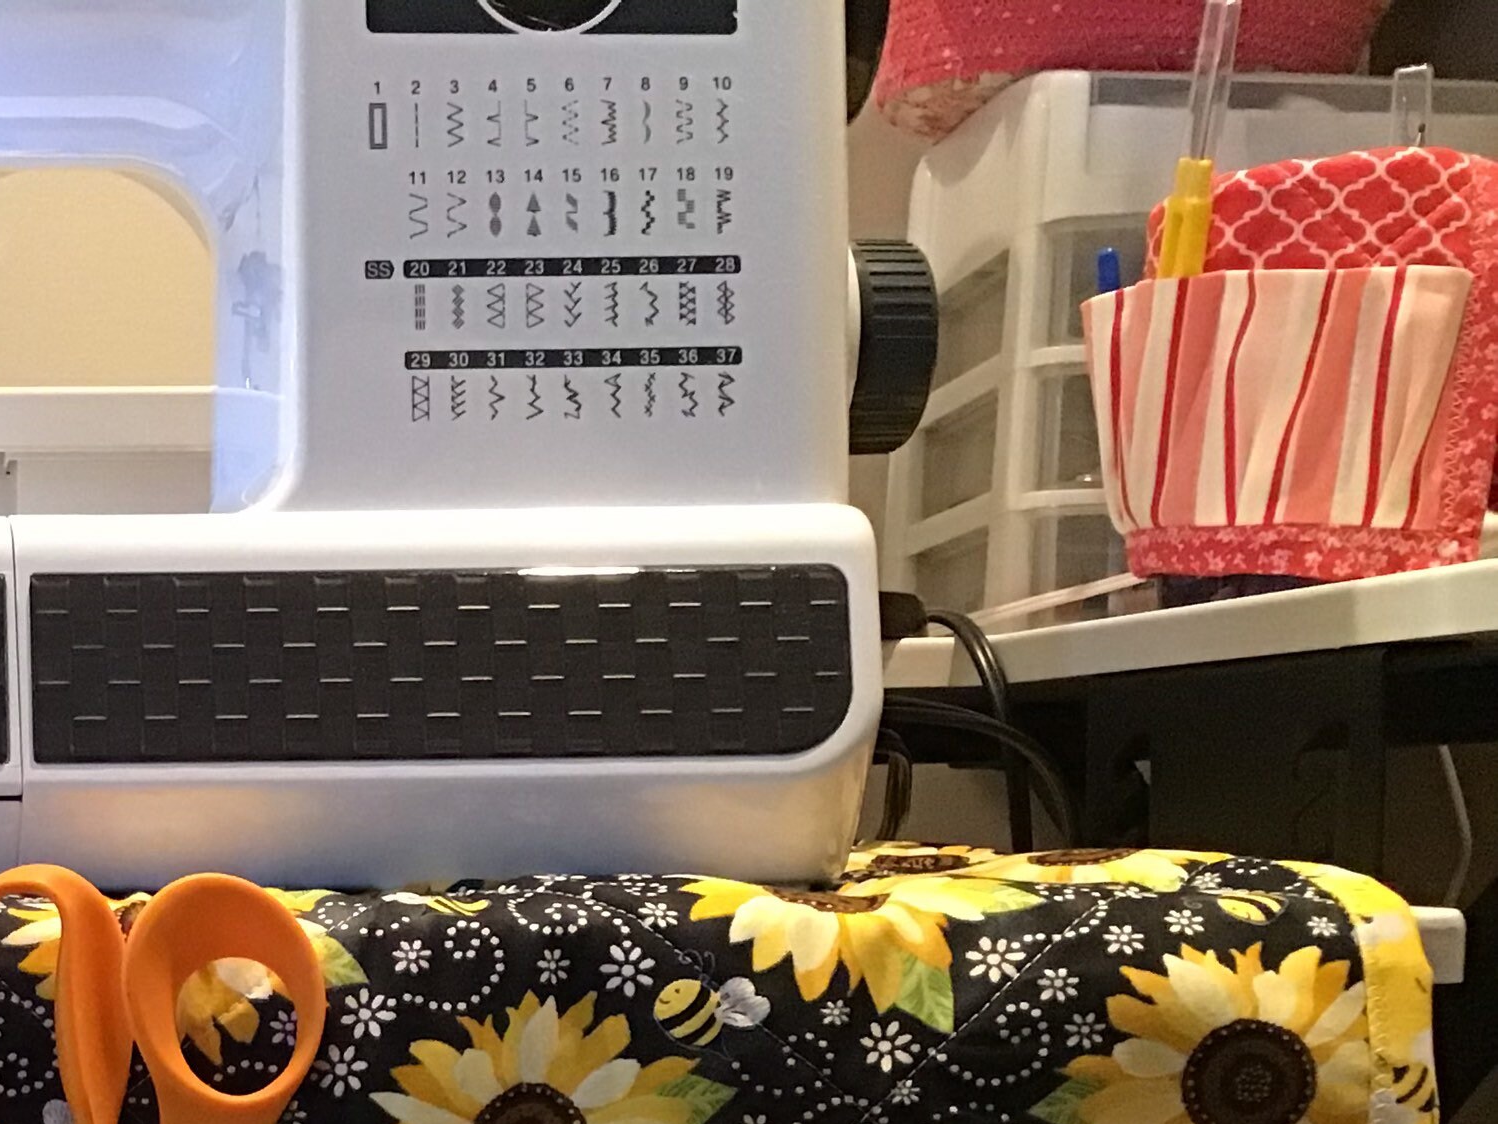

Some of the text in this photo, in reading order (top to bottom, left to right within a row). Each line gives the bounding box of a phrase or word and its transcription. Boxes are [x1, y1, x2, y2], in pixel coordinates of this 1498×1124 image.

[373, 75, 732, 96] 1 2 3 4 5 6 7 8 9 10
[408, 165, 734, 186] 11 12 13 14 15 16 17 18 19
[367, 262, 390, 277] SS
[410, 257, 735, 276] 20 21 22 23 24 25 26 27 28
[411, 348, 736, 368] 29 30 31 32 33 34 35 36 37
